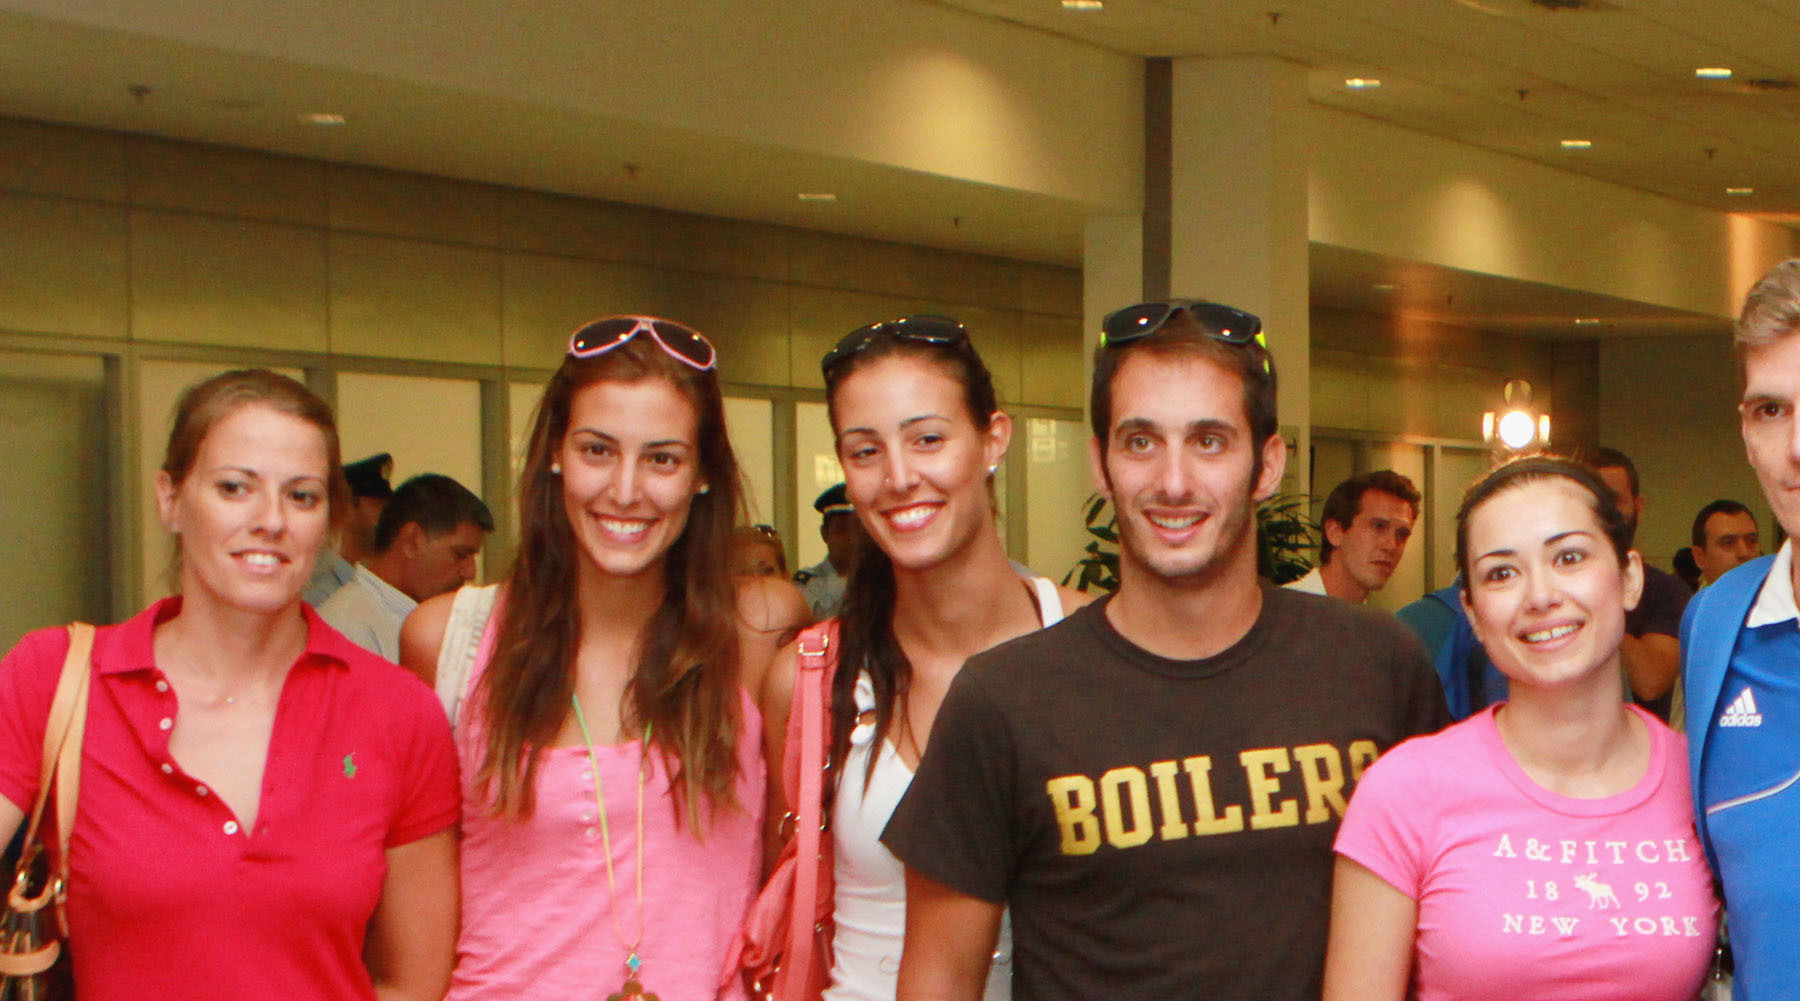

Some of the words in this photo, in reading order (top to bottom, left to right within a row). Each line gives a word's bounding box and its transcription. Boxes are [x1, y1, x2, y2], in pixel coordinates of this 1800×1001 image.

[1719, 713, 1763, 728] adidas
[1502, 913, 1580, 936] NEW
[1609, 915, 1701, 937] YORK
